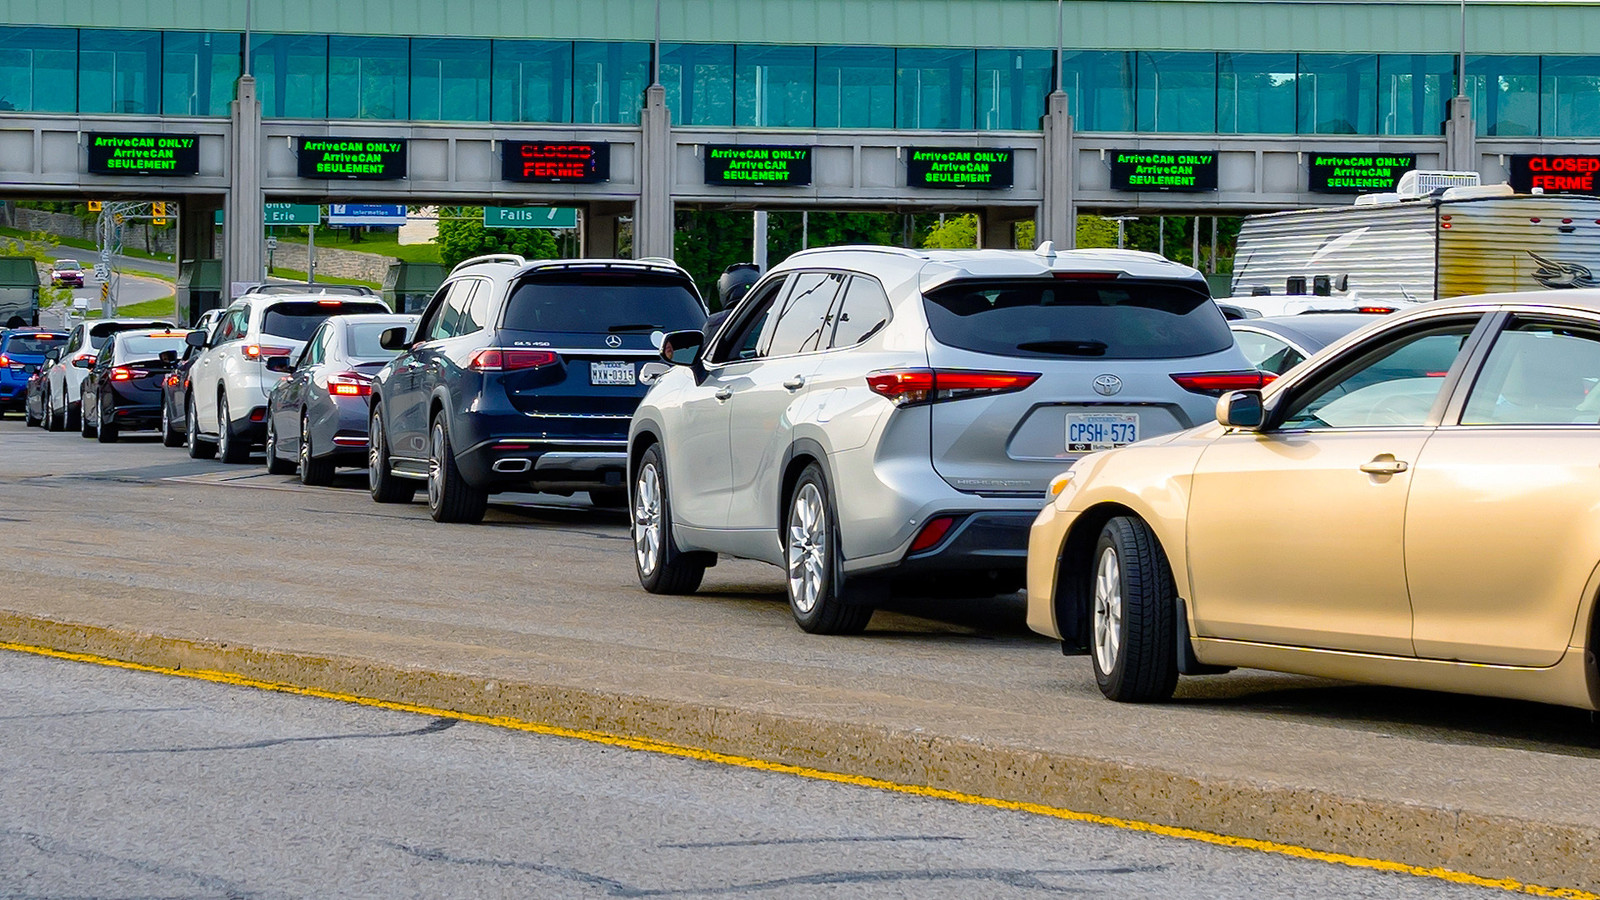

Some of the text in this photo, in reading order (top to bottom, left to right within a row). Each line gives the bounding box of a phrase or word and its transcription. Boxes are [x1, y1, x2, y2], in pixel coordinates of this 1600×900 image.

[94, 137, 194, 148] ArriveCAN ONLY/
[304, 141, 401, 153] ArriveCAN ONLY/
[113, 148, 174, 158] ArriveCAN
[323, 153, 382, 162] ArriveCAN
[711, 149, 807, 159] ArriveCAN ONLY/
[913, 151, 1009, 162] ArriveCAN ONLY/
[107, 159, 177, 169] SEULEMENT
[729, 160, 787, 169] ArriveCAN
[1117, 154, 1213, 165] ArriveCAN ONLY/
[1315, 157, 1411, 167] ArriveCAN ONLY/
[1528, 157, 1600, 172] CLOSED
[317, 163, 385, 173] SEULEMENT
[931, 163, 990, 172] ArriveCAN
[1136, 165, 1194, 174] ArriveCAN
[1333, 167, 1392, 177] ArriveCAN
[723, 170, 790, 180] SEULEMENT
[925, 173, 993, 183] SEULEMENT
[1129, 175, 1197, 185] SEULEMENT
[1327, 178, 1395, 188] SEULEMENT
[1532, 172, 1594, 190] FERMÉ
[273, 211, 296, 221] Erie
[500, 209, 533, 220] Falls
[1070, 423, 1136, 442] CPSH 573
